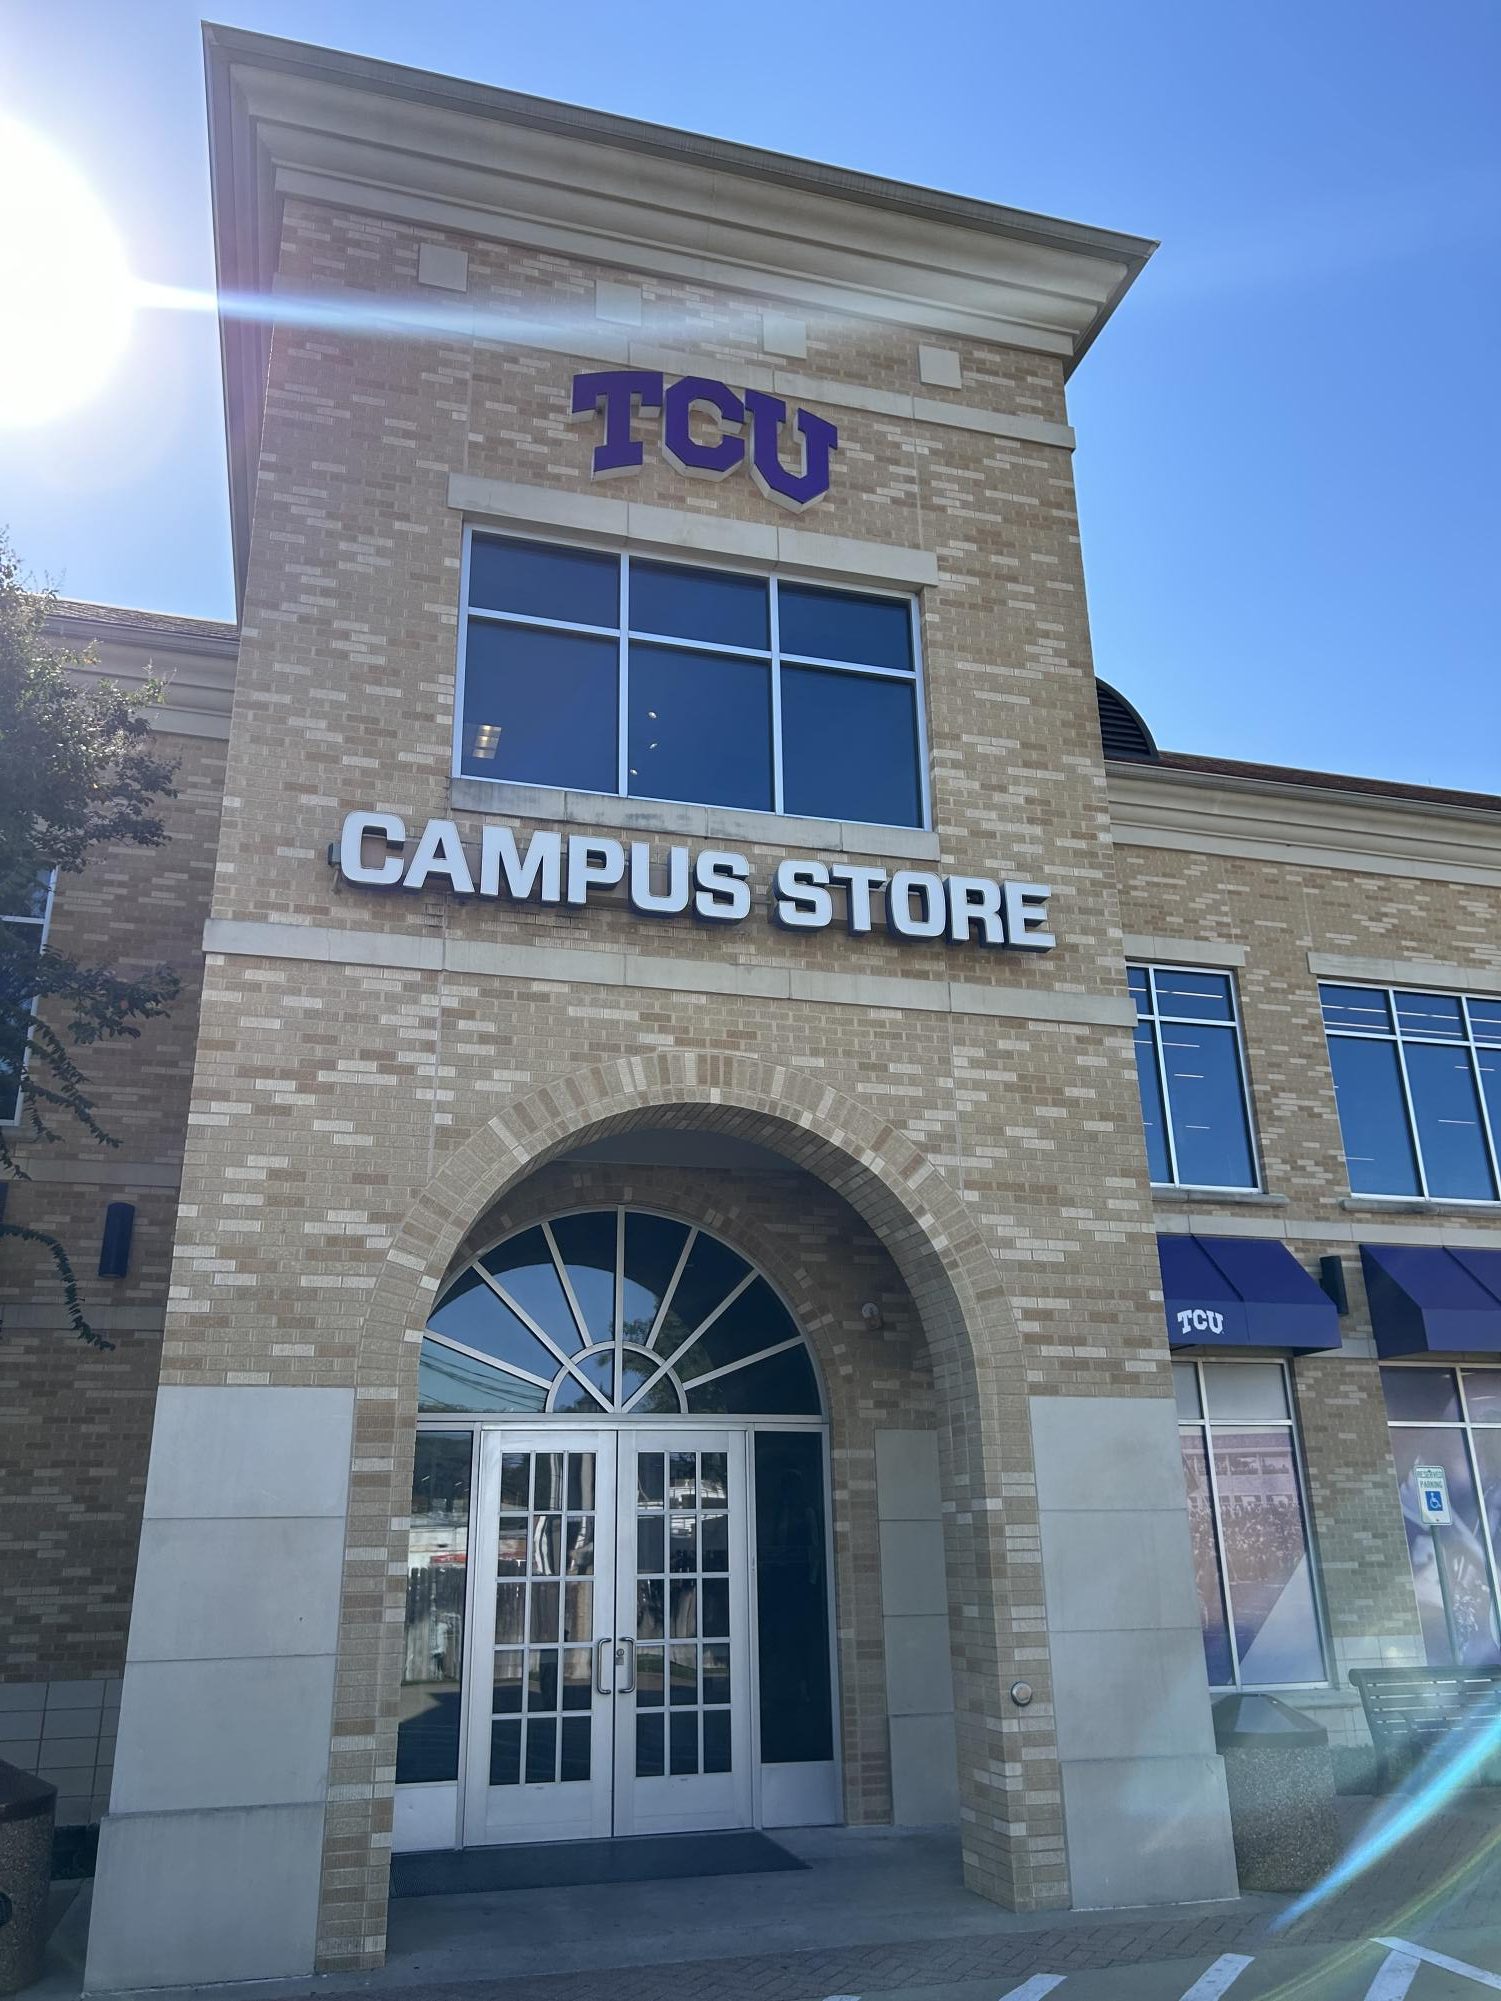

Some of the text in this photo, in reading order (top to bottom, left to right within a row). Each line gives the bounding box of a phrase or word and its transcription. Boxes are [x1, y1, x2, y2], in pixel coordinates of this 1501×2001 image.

[571, 370, 839, 513] TCU
[338, 809, 1057, 954] CAMPUS STORE
[1177, 1309, 1224, 1335] TCU
[1420, 1480, 1443, 1489] PARKING
